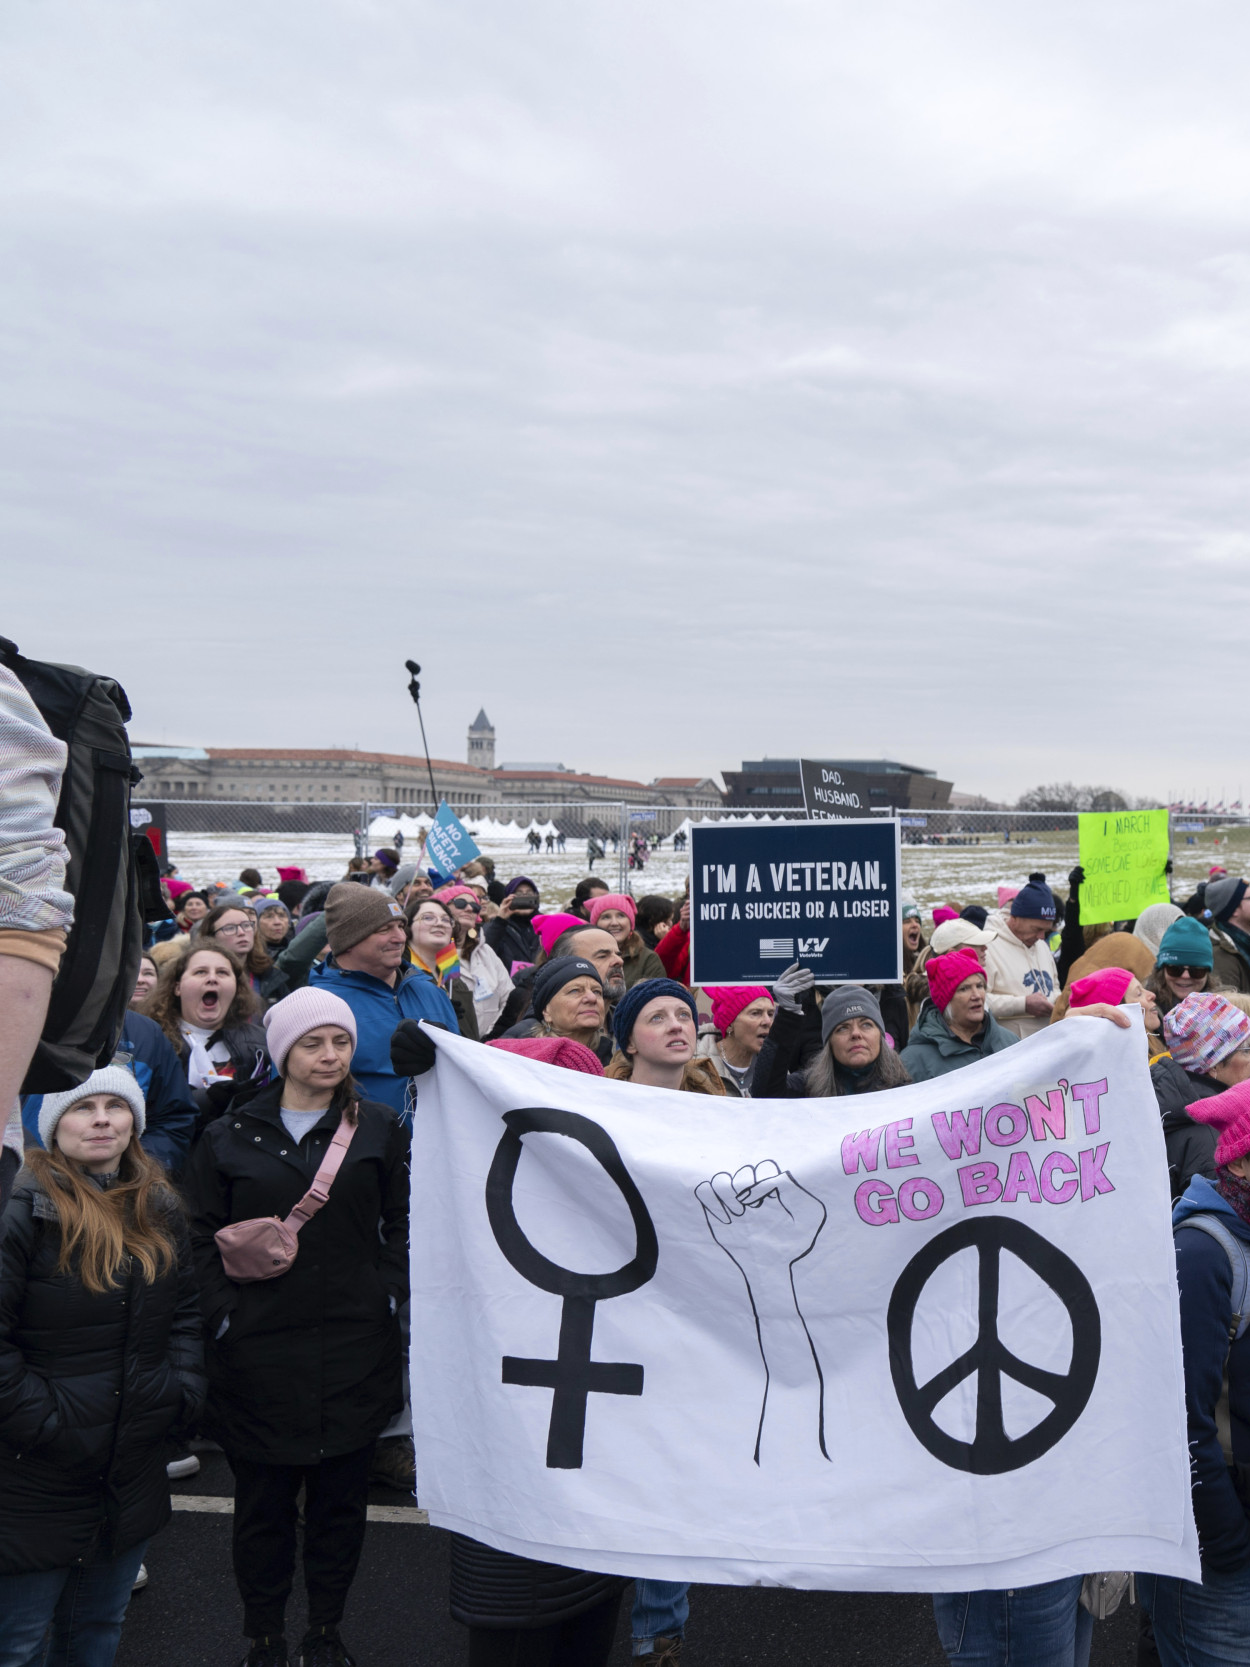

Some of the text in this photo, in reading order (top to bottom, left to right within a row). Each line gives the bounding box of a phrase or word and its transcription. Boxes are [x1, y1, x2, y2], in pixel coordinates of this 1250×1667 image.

[821, 768, 845, 786] DAD.
[813, 785, 864, 809] HUSBAND.
[445, 823, 462, 841] NO
[1115, 815, 1150, 835] MARCH
[433, 820, 461, 857] SAFETY
[703, 861, 887, 894] I'M A VETERAN,
[1084, 879, 1131, 907] MARCHED
[700, 900, 890, 921] NOT A SUCKER OR A LOSER
[840, 1077, 1109, 1176] WE WON'T
[854, 1141, 1116, 1227] GO BACK
